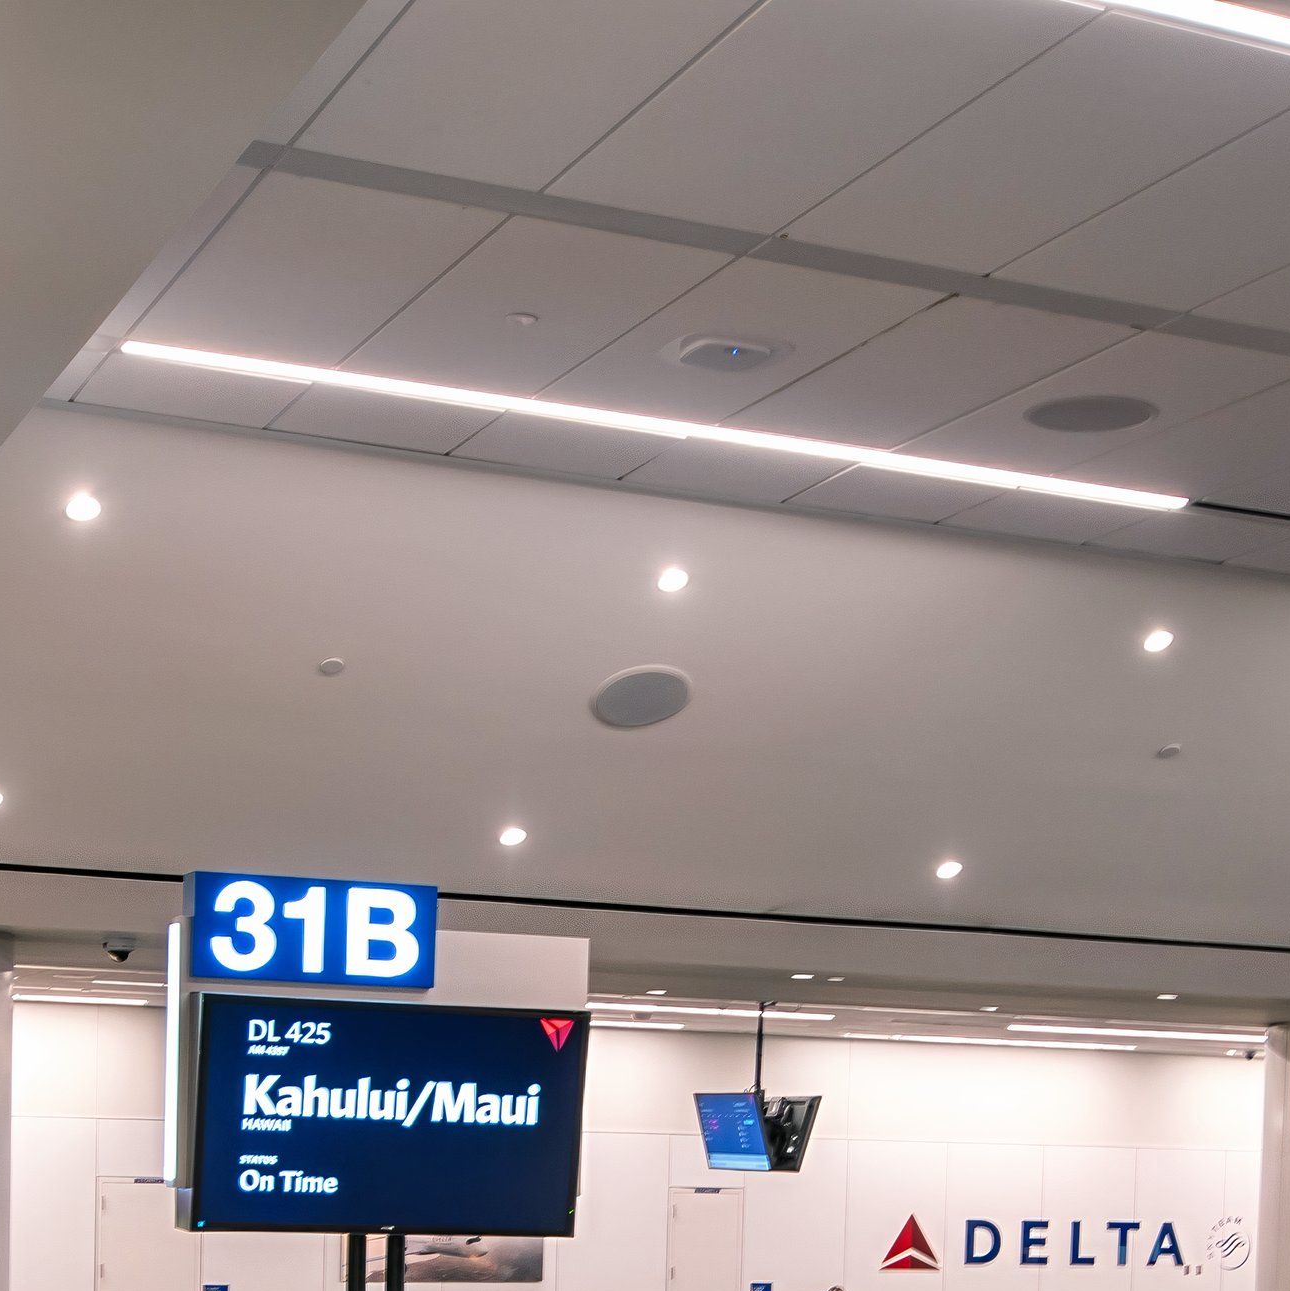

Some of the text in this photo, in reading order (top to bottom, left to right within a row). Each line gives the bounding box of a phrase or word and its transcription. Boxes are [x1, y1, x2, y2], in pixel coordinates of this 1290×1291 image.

[210, 880, 420, 978] 31B
[247, 1019, 332, 1045] DL 425
[242, 1073, 541, 1128] Kahului/Maui
[241, 1118, 292, 1132] HAWAII
[238, 1155, 278, 1165] STATUS
[238, 1169, 339, 1193] On Time
[964, 1219, 1184, 1267] DELTA
